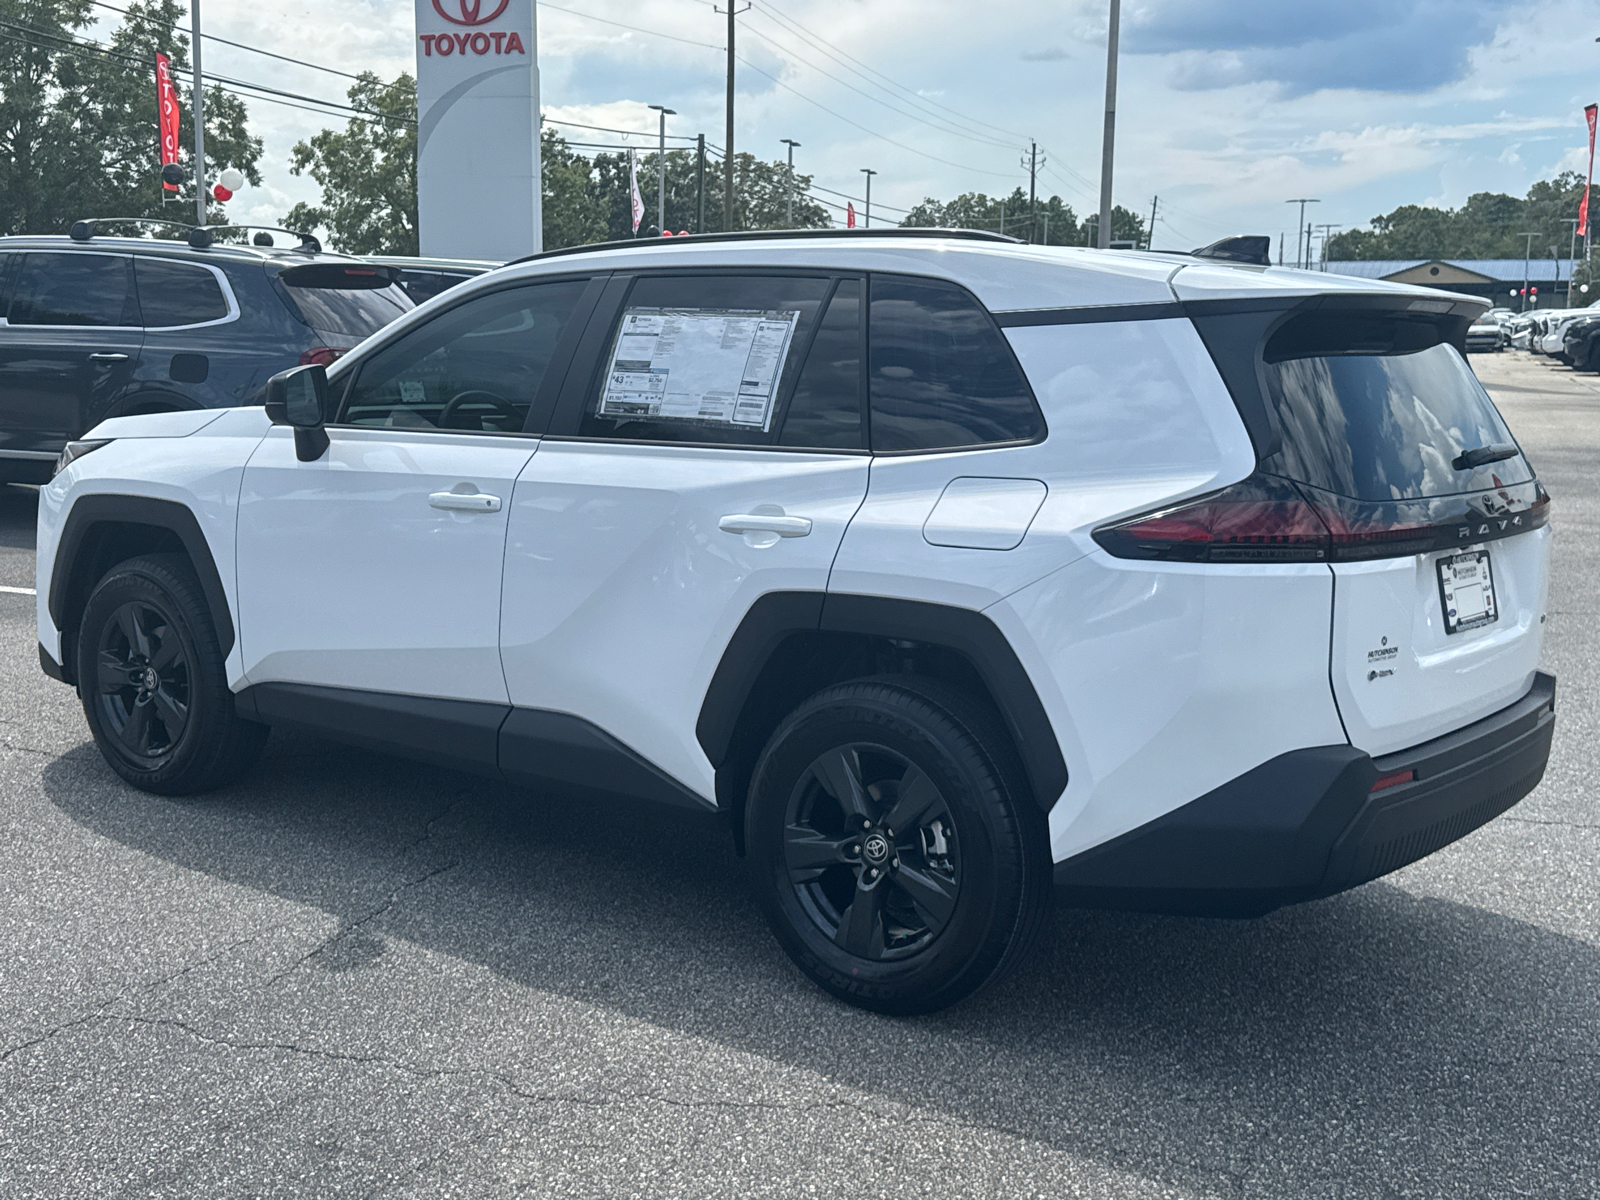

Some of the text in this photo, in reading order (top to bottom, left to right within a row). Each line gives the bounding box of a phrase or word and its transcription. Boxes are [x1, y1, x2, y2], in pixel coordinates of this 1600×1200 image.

[420, 31, 525, 57] TOYOTA
[162, 83, 175, 165] TOYOT
[1458, 516, 1522, 538] RAV4
